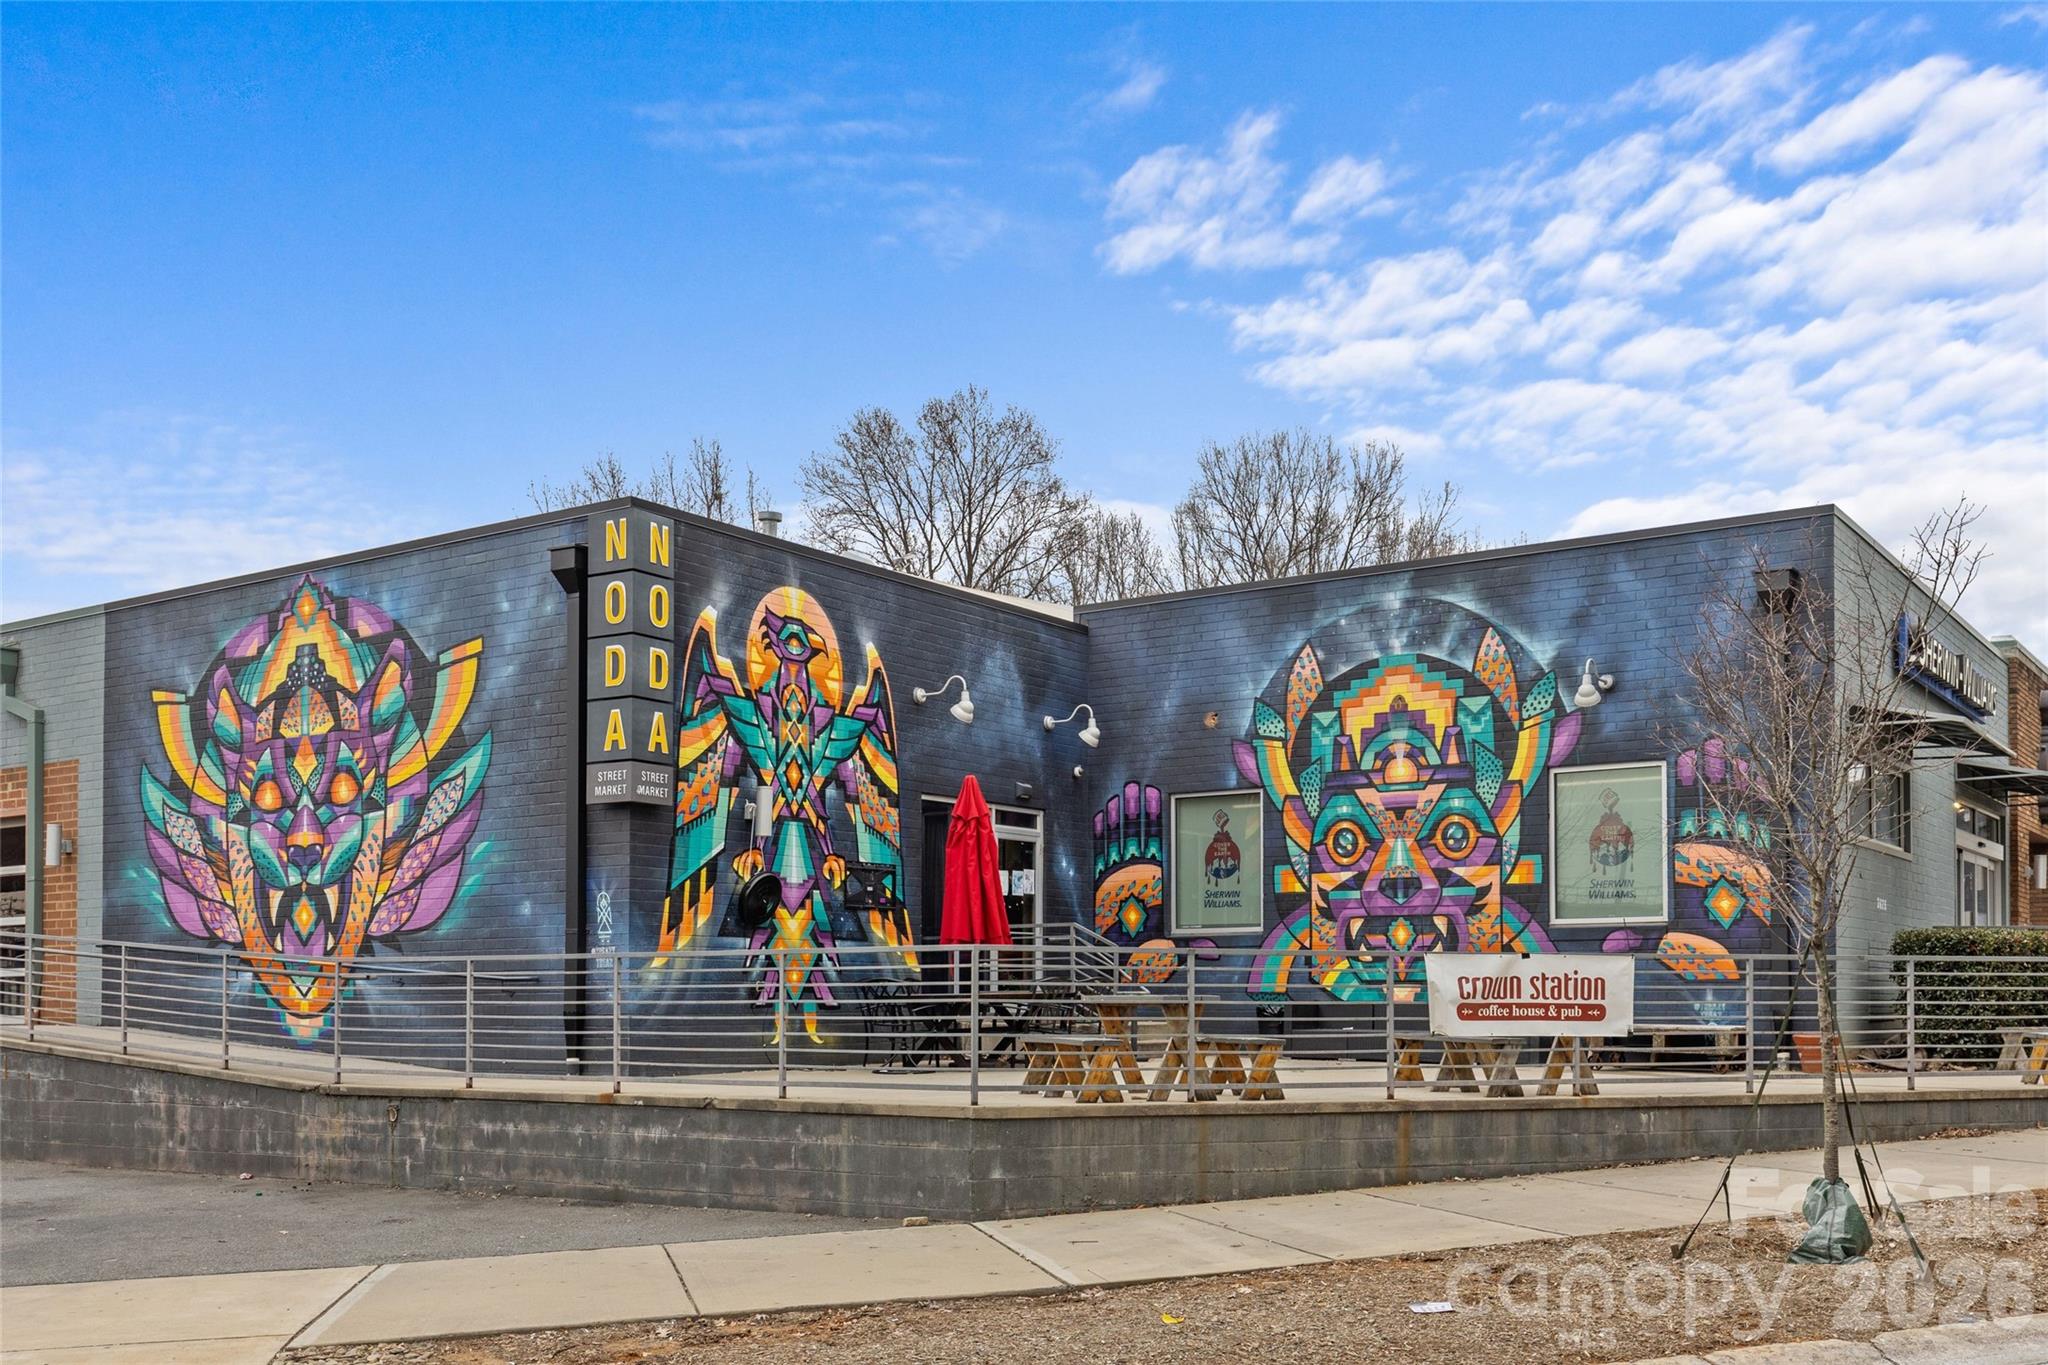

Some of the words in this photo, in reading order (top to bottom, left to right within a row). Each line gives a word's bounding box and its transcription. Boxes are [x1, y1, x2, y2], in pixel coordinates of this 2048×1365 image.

[603, 517, 627, 752] NODA
[648, 521, 670, 755] NODA
[597, 769, 628, 782] STREET
[641, 770, 669, 784] STREET
[594, 784, 627, 797] MARKET
[638, 784, 669, 798] MARKET
[1589, 878, 1635, 889] SHERWIN
[1204, 889, 1241, 899] SHERWIN
[1457, 975, 1522, 1001] crown
[1529, 969, 1606, 1001] station
[1478, 1005, 1510, 1017] coffee
[1512, 1004, 1545, 1017] house
[1548, 1005, 1558, 1017] &
[1561, 1005, 1582, 1020] pub
